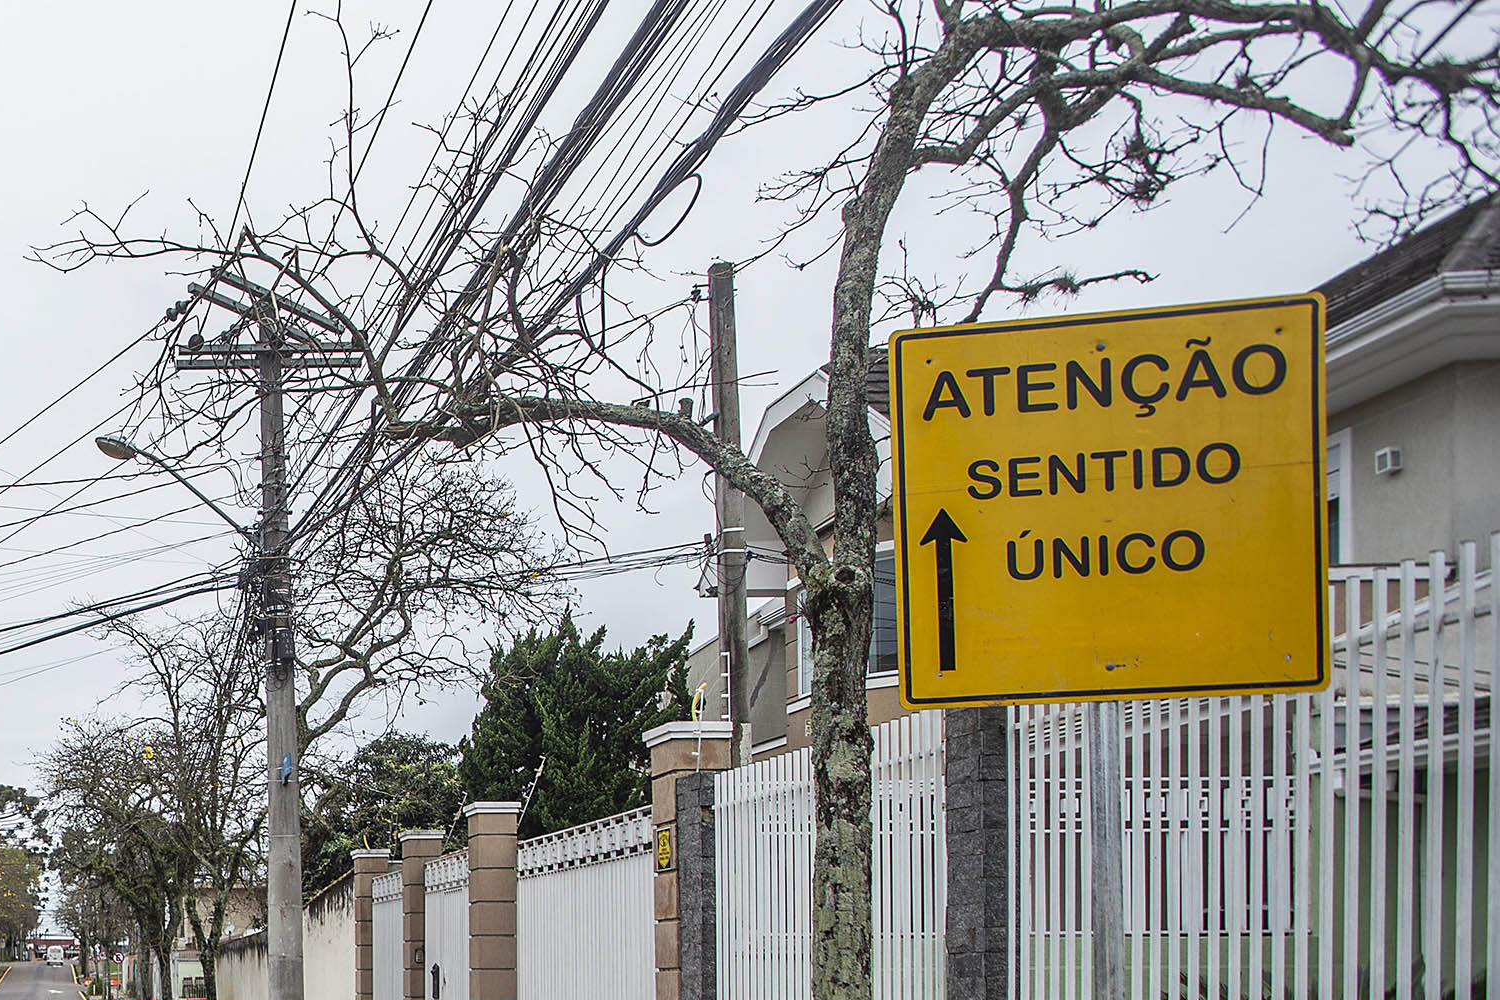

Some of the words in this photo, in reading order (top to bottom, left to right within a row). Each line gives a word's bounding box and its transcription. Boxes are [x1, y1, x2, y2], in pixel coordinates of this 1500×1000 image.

[922, 336, 1287, 421] ATENÇÃO
[967, 442, 1241, 500] SENTIDO
[1006, 529, 1206, 581] ÚNICO
